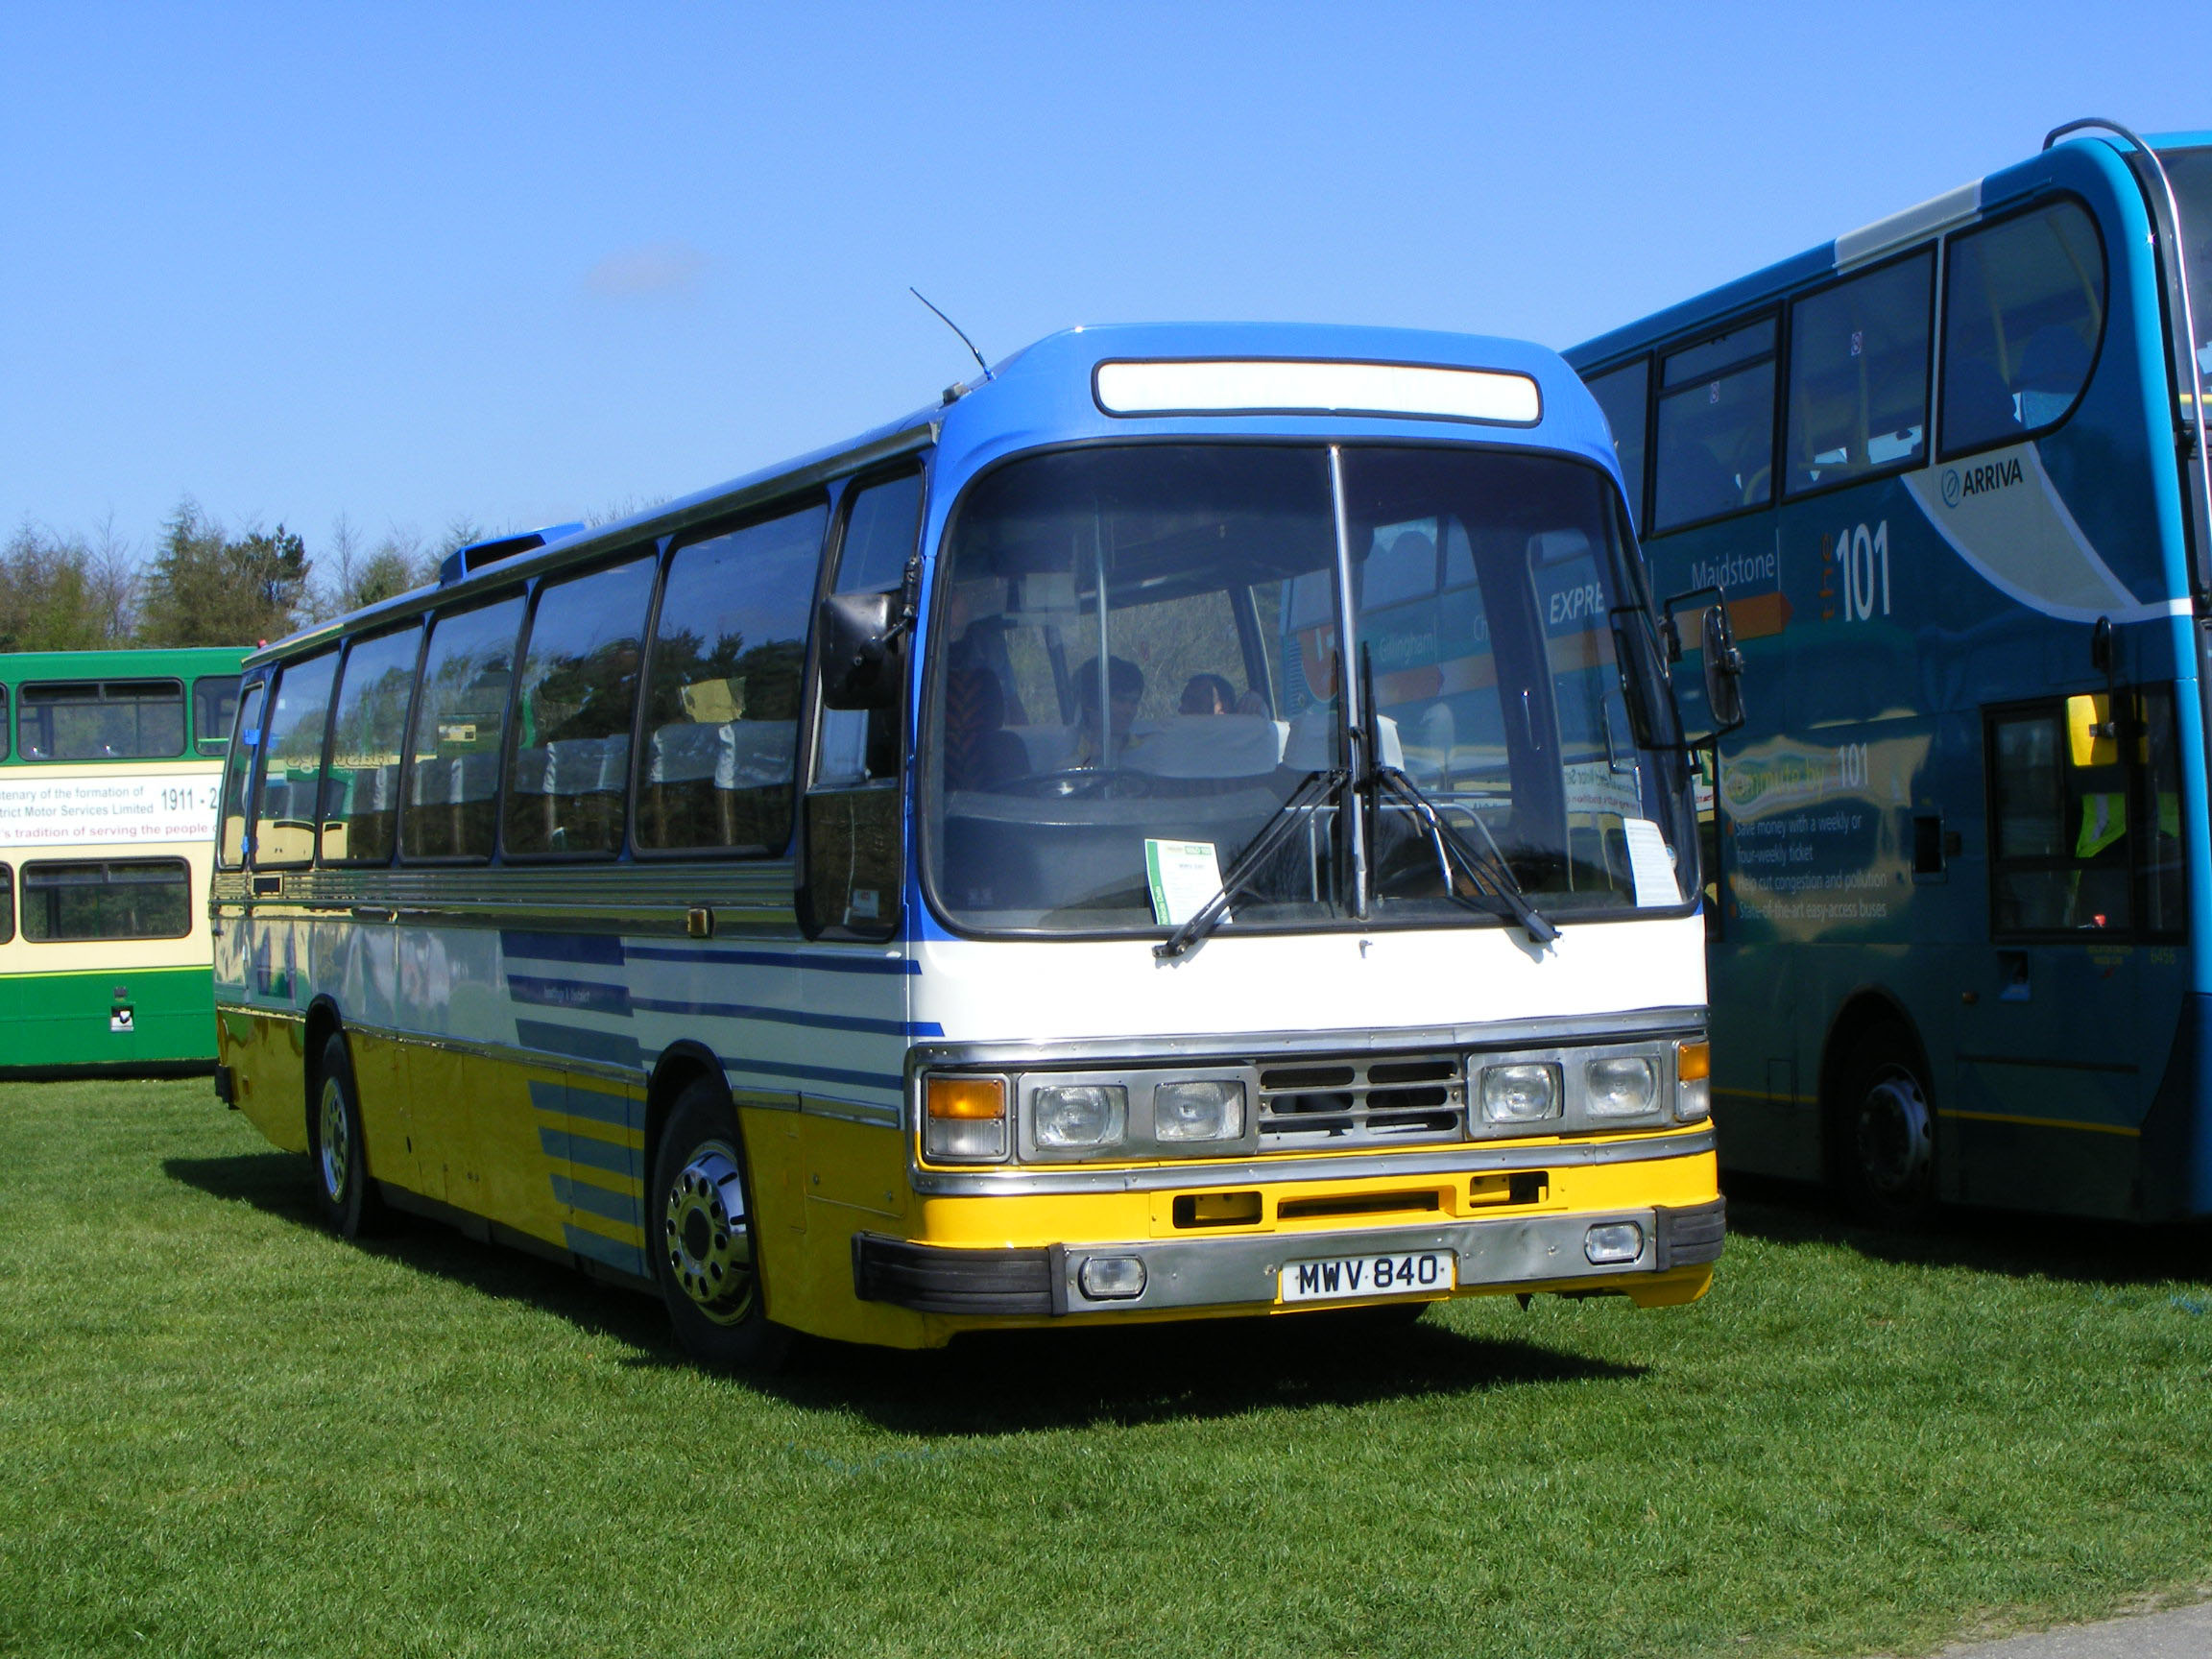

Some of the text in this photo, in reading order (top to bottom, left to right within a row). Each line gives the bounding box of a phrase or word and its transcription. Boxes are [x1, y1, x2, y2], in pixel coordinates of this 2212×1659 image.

[1961, 458, 2024, 497] ARRIVA
[1692, 552, 1775, 589] Maidstone
[1836, 519, 1890, 622] 101
[1838, 742, 1868, 788] 101
[40, 787, 51, 799] of
[55, 786, 72, 798] the
[75, 785, 130, 799] formation
[133, 785, 145, 798] of
[160, 787, 195, 810] 1911
[24, 805, 57, 817] Motor
[60, 805, 108, 816] Services
[112, 803, 154, 814] Limited
[15, 827, 69, 838] tradition
[73, 826, 85, 836] of
[89, 826, 137, 839] serving
[141, 823, 161, 834] the
[165, 822, 208, 836] people
[1736, 811, 1863, 838] Save money with a weekly or
[1737, 843, 1814, 866] four-weekly ticket
[1737, 869, 1887, 894] Help cut congestion and pollution
[1860, 899, 1887, 918] buses
[1299, 1255, 1437, 1294] MWV 840
